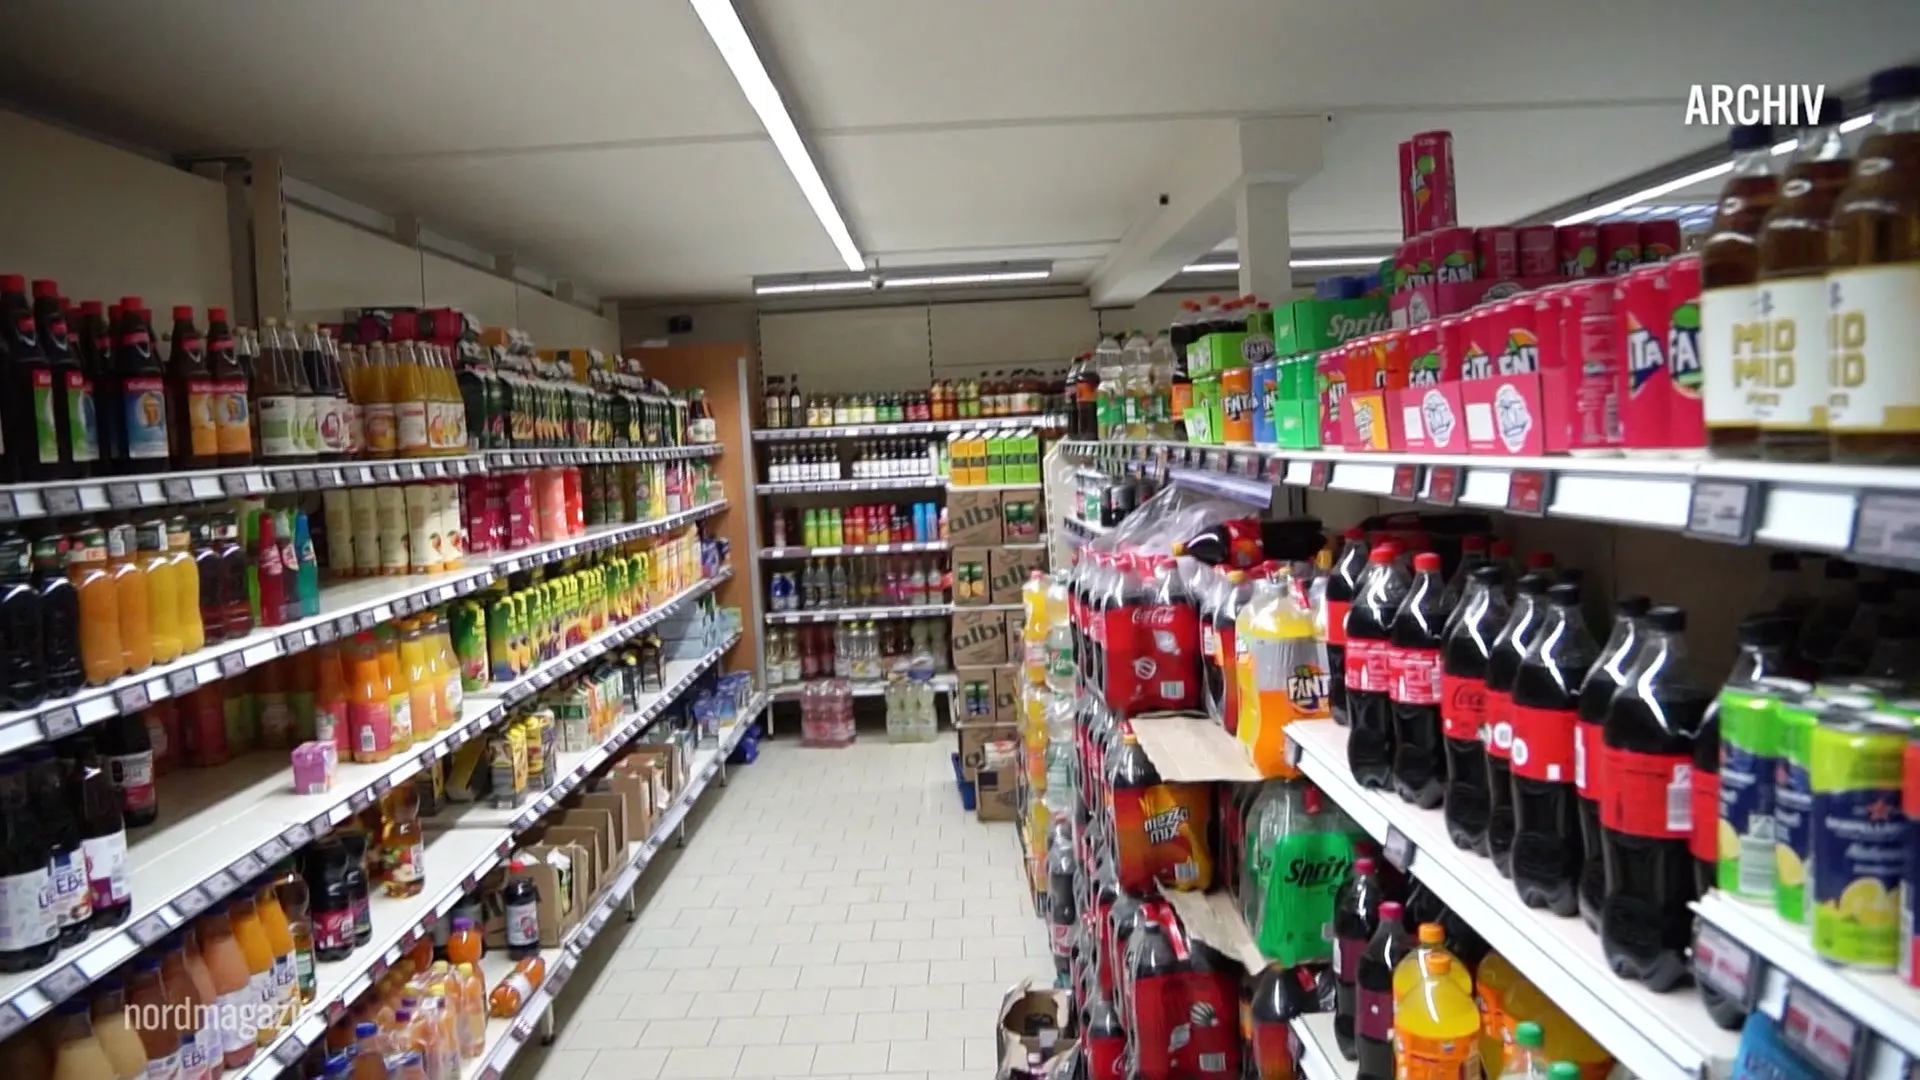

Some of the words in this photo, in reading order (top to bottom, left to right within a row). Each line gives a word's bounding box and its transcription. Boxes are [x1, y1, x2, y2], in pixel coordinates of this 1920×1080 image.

[1732, 318, 1797, 354] MIO
[1732, 355, 1796, 389] MIO
[950, 498, 1000, 533] albi
[955, 615, 1006, 650] albi
[1287, 673, 1331, 701] FANT
[1144, 805, 1188, 832] mezzo
[1151, 821, 1179, 844] mix
